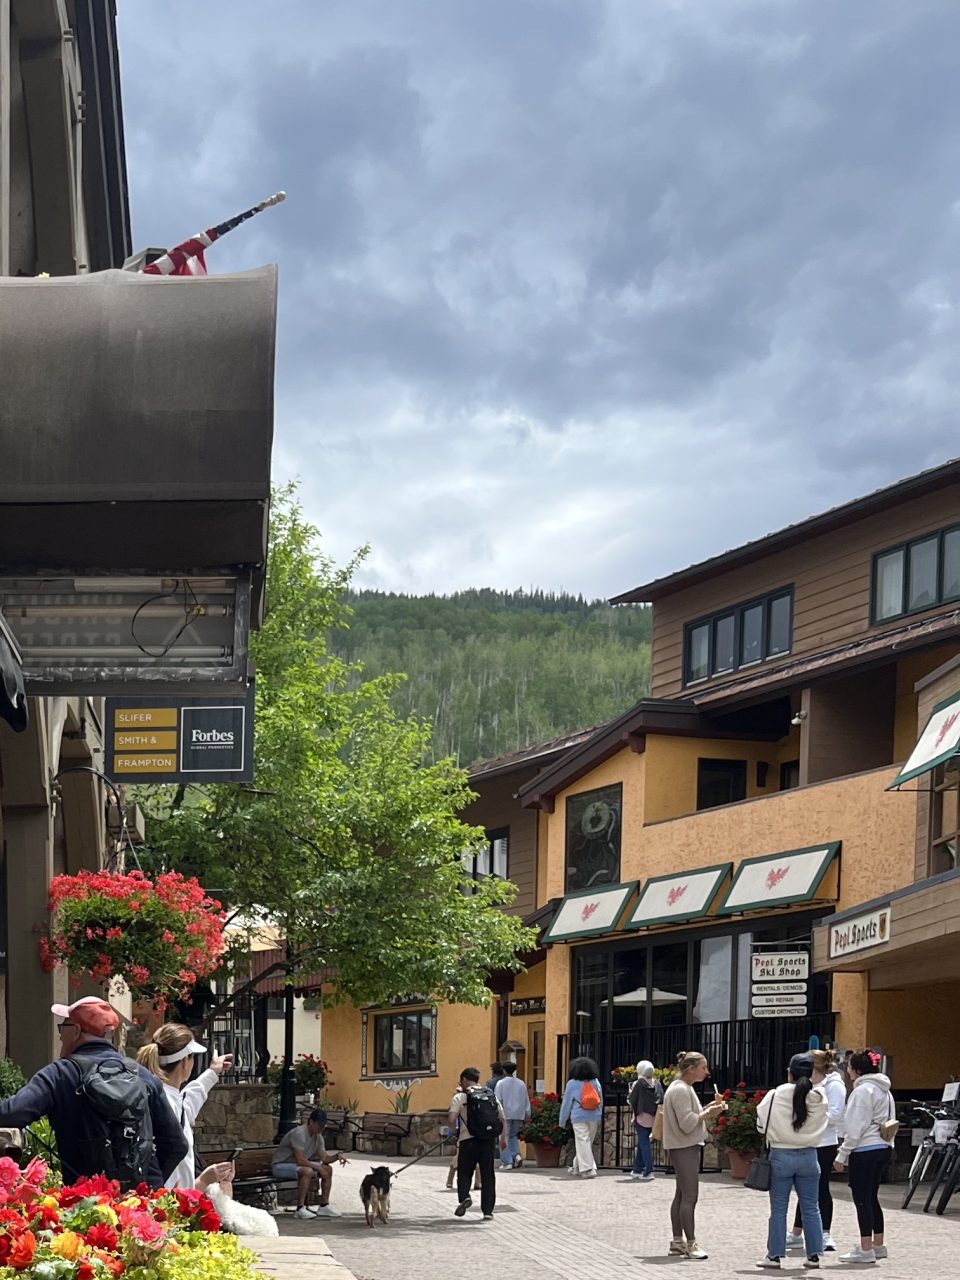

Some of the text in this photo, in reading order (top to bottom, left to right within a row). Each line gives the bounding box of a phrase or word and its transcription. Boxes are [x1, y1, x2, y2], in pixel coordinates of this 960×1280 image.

[119, 714, 152, 722] SLIFER
[191, 729, 234, 742] Forbes
[119, 736, 157, 745] SMITH &
[118, 759, 172, 767] FRAMPTON
[851, 919, 877, 947] Sports
[777, 957, 806, 966] Sports
[778, 967, 801, 977] Shop
